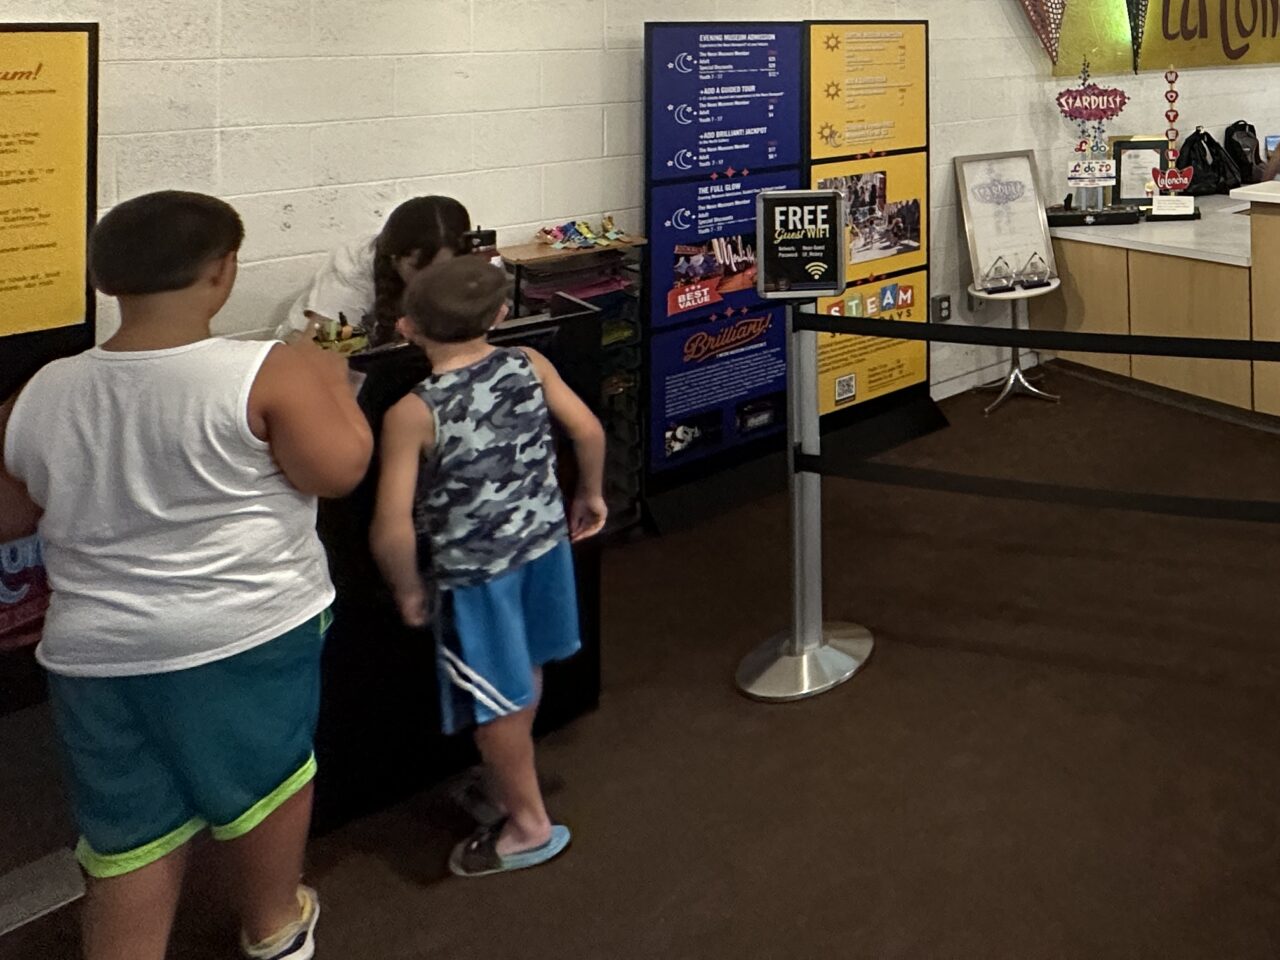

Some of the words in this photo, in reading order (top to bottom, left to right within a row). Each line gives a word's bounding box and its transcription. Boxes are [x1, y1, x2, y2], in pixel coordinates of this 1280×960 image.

[1060, 95, 1122, 110] STARDUST
[1166, 70, 1178, 160] MOTEL
[745, 127, 768, 135] JACKPOT
[698, 186, 709, 194] THE
[710, 185, 724, 193] FULL
[724, 183, 741, 191] GLOW
[774, 205, 829, 230] FREE
[773, 228, 805, 244] Guest
[806, 224, 830, 238] WIFI
[677, 287, 710, 303] BEST
[678, 294, 710, 309] VALUE
